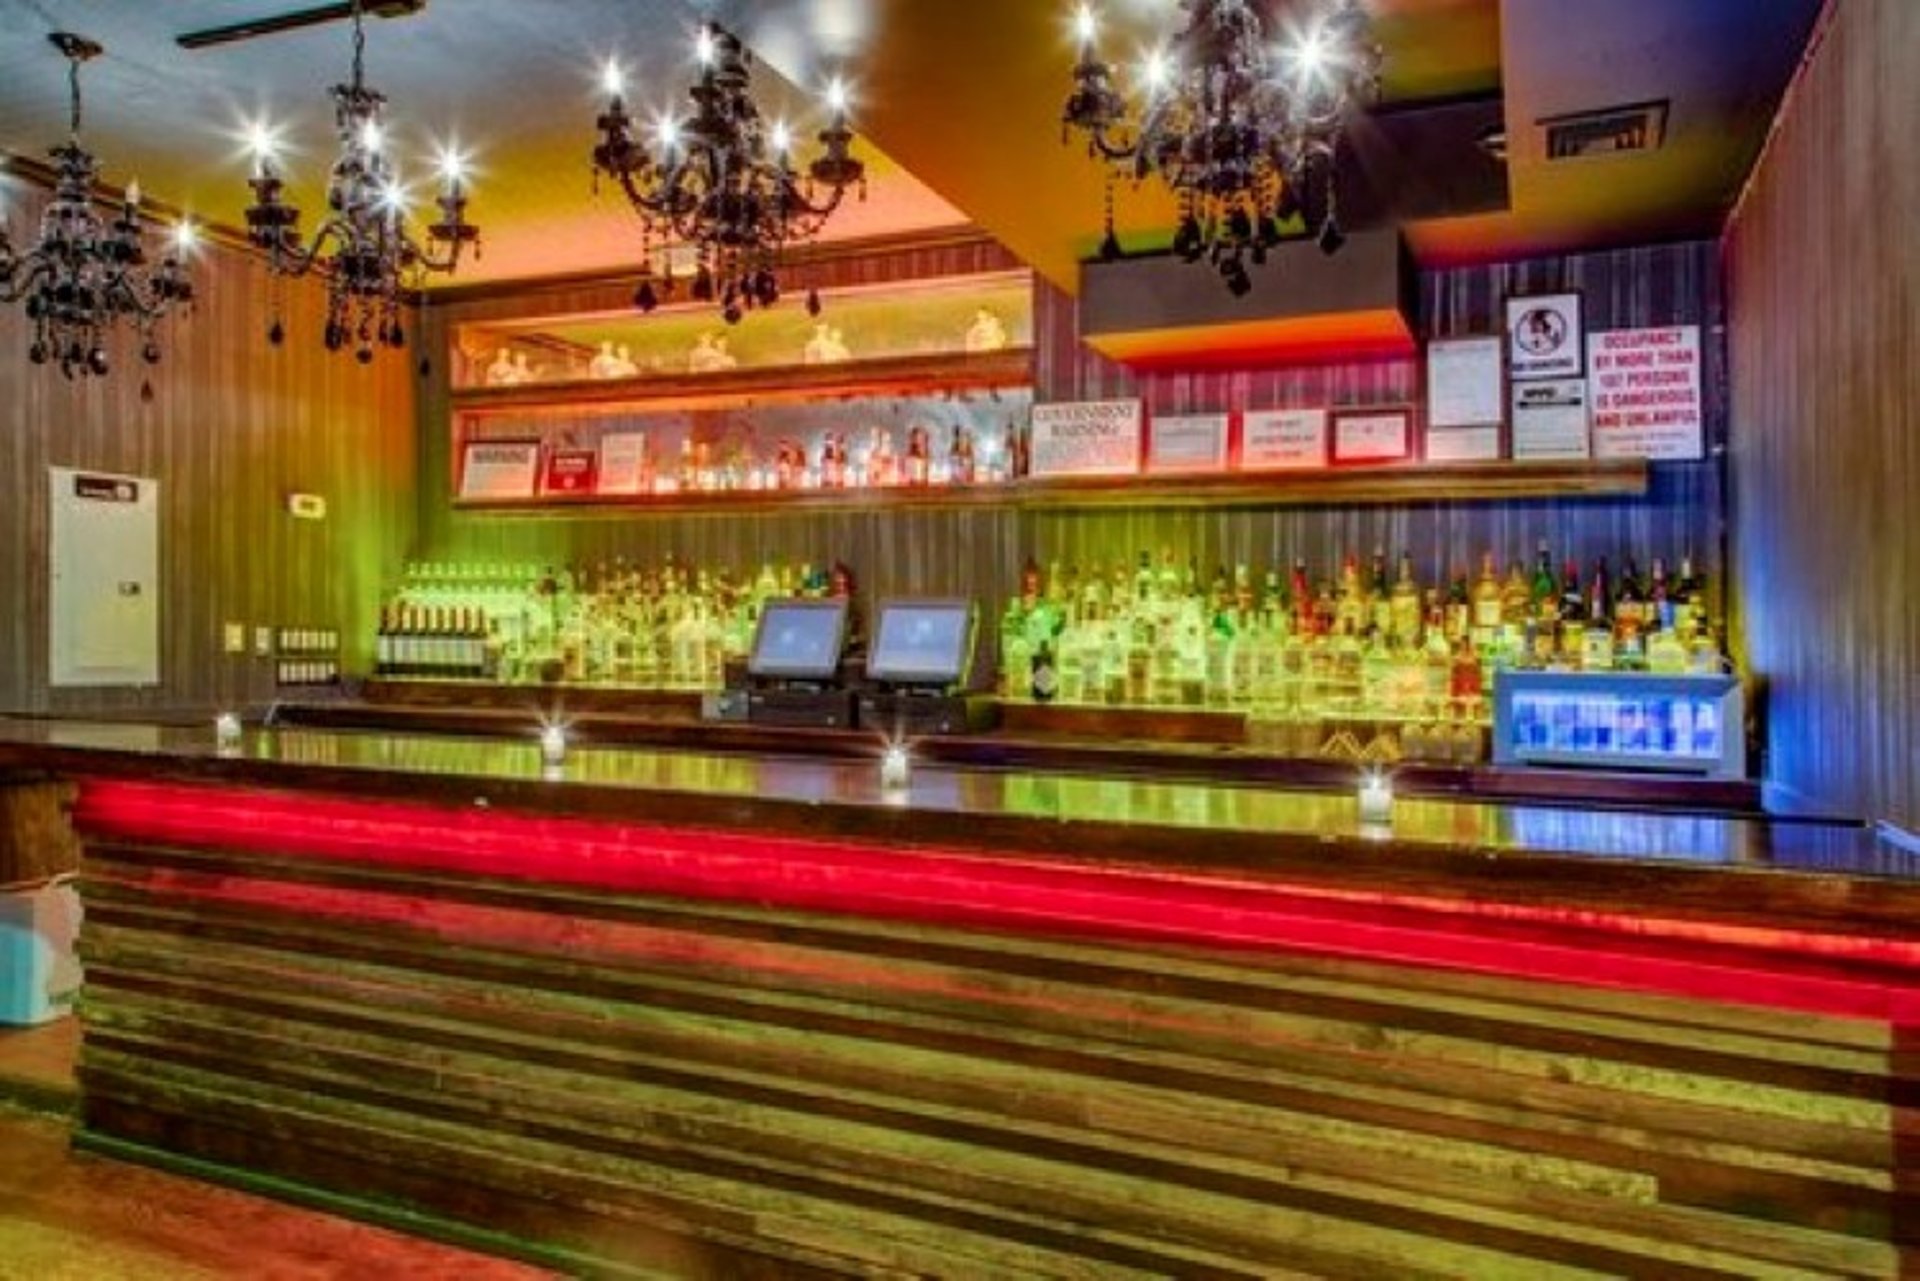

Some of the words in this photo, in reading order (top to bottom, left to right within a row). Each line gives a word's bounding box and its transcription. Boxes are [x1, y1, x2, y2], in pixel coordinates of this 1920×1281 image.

[1604, 332, 1682, 349] OCCUPANCY
[1596, 354, 1612, 370] BY
[1615, 351, 1653, 367] MORE
[1657, 349, 1693, 364] THAN
[1627, 370, 1689, 387] PERSONS
[1612, 389, 1697, 407] DANGEROUS
[1596, 411, 1620, 428] AND
